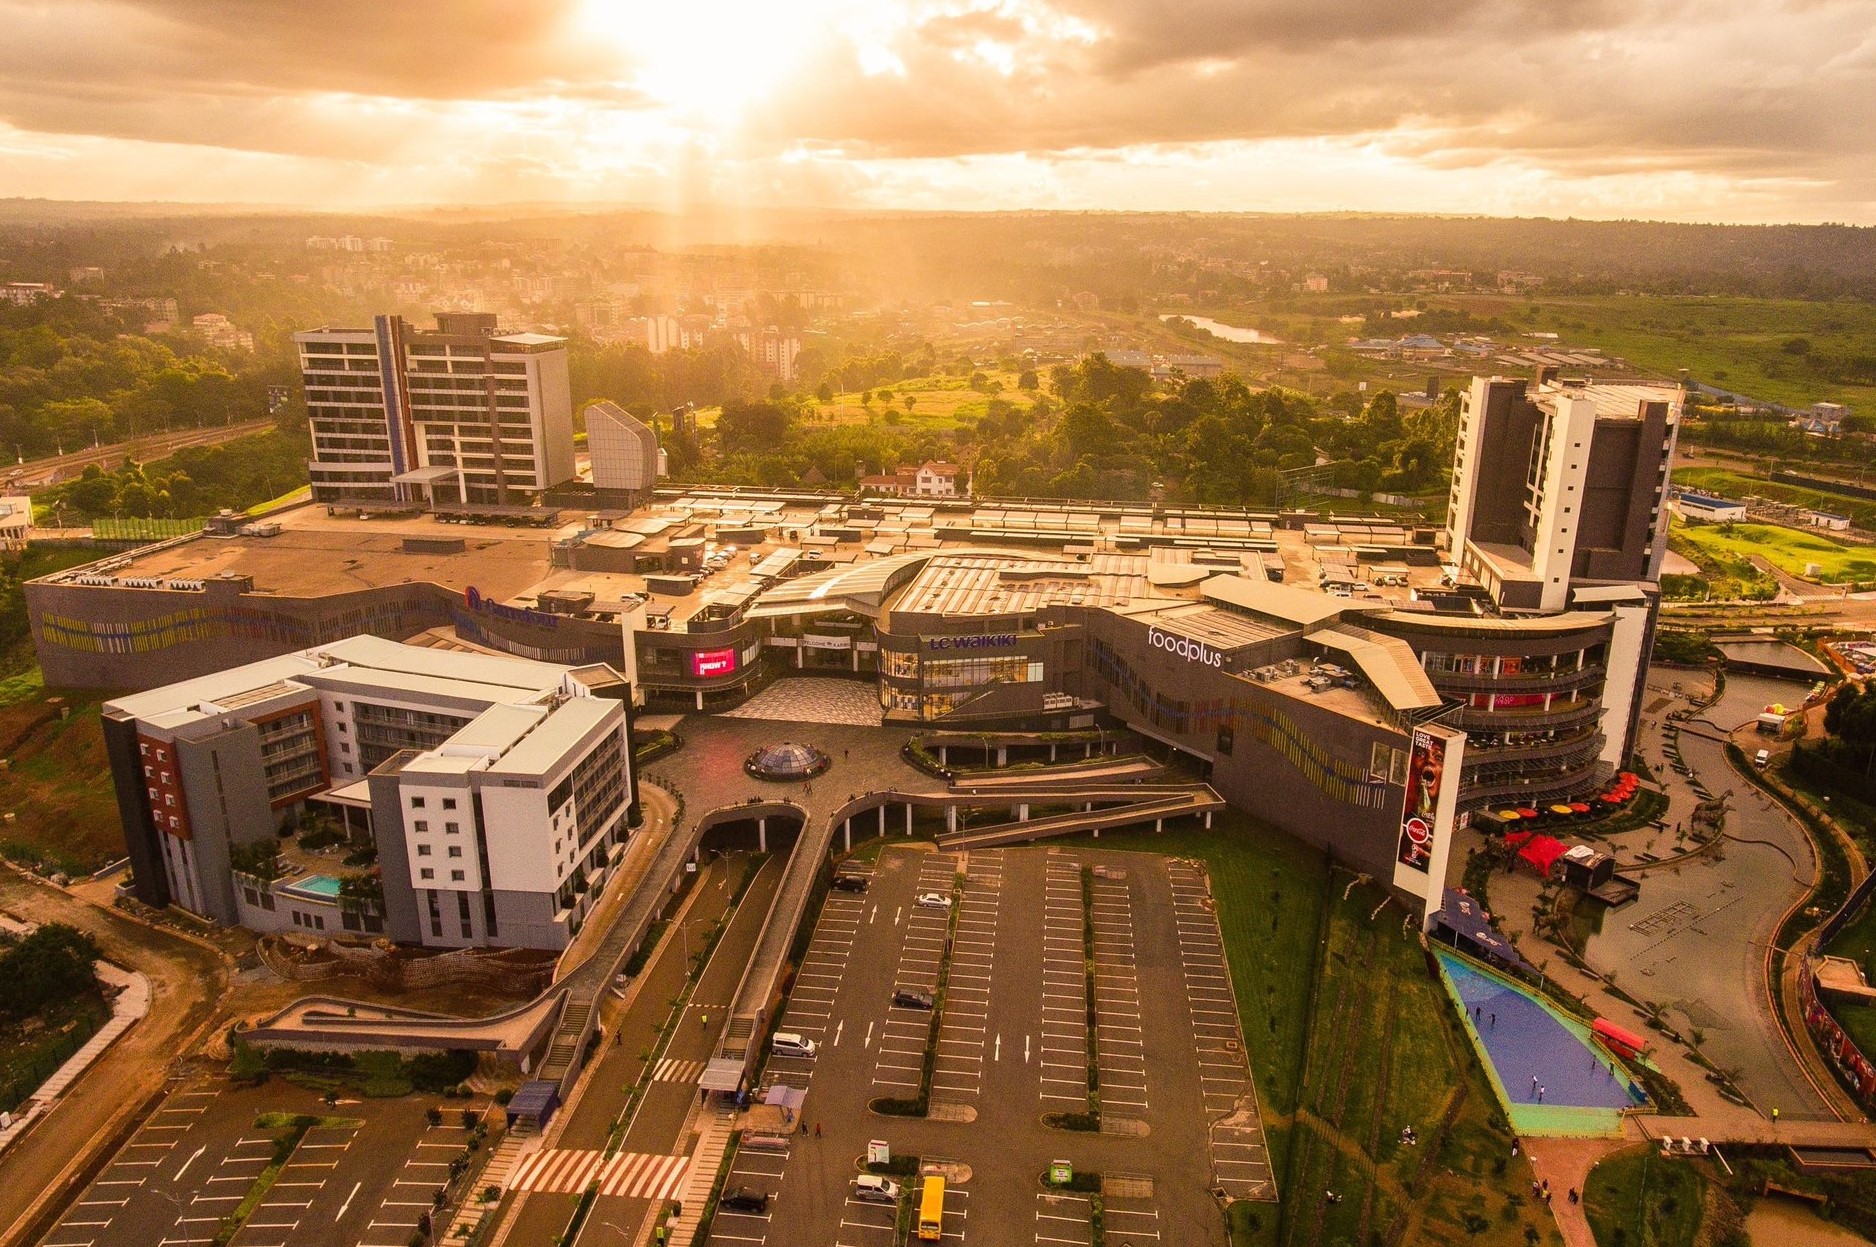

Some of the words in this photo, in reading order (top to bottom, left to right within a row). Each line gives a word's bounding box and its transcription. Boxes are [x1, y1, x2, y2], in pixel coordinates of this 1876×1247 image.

[930, 637, 950, 650] LC
[1148, 625, 1221, 667] foodplus
[1416, 732, 1430, 740] LOVE
[1416, 736, 1433, 745] GREAT
[1415, 741, 1432, 749] TASTE
